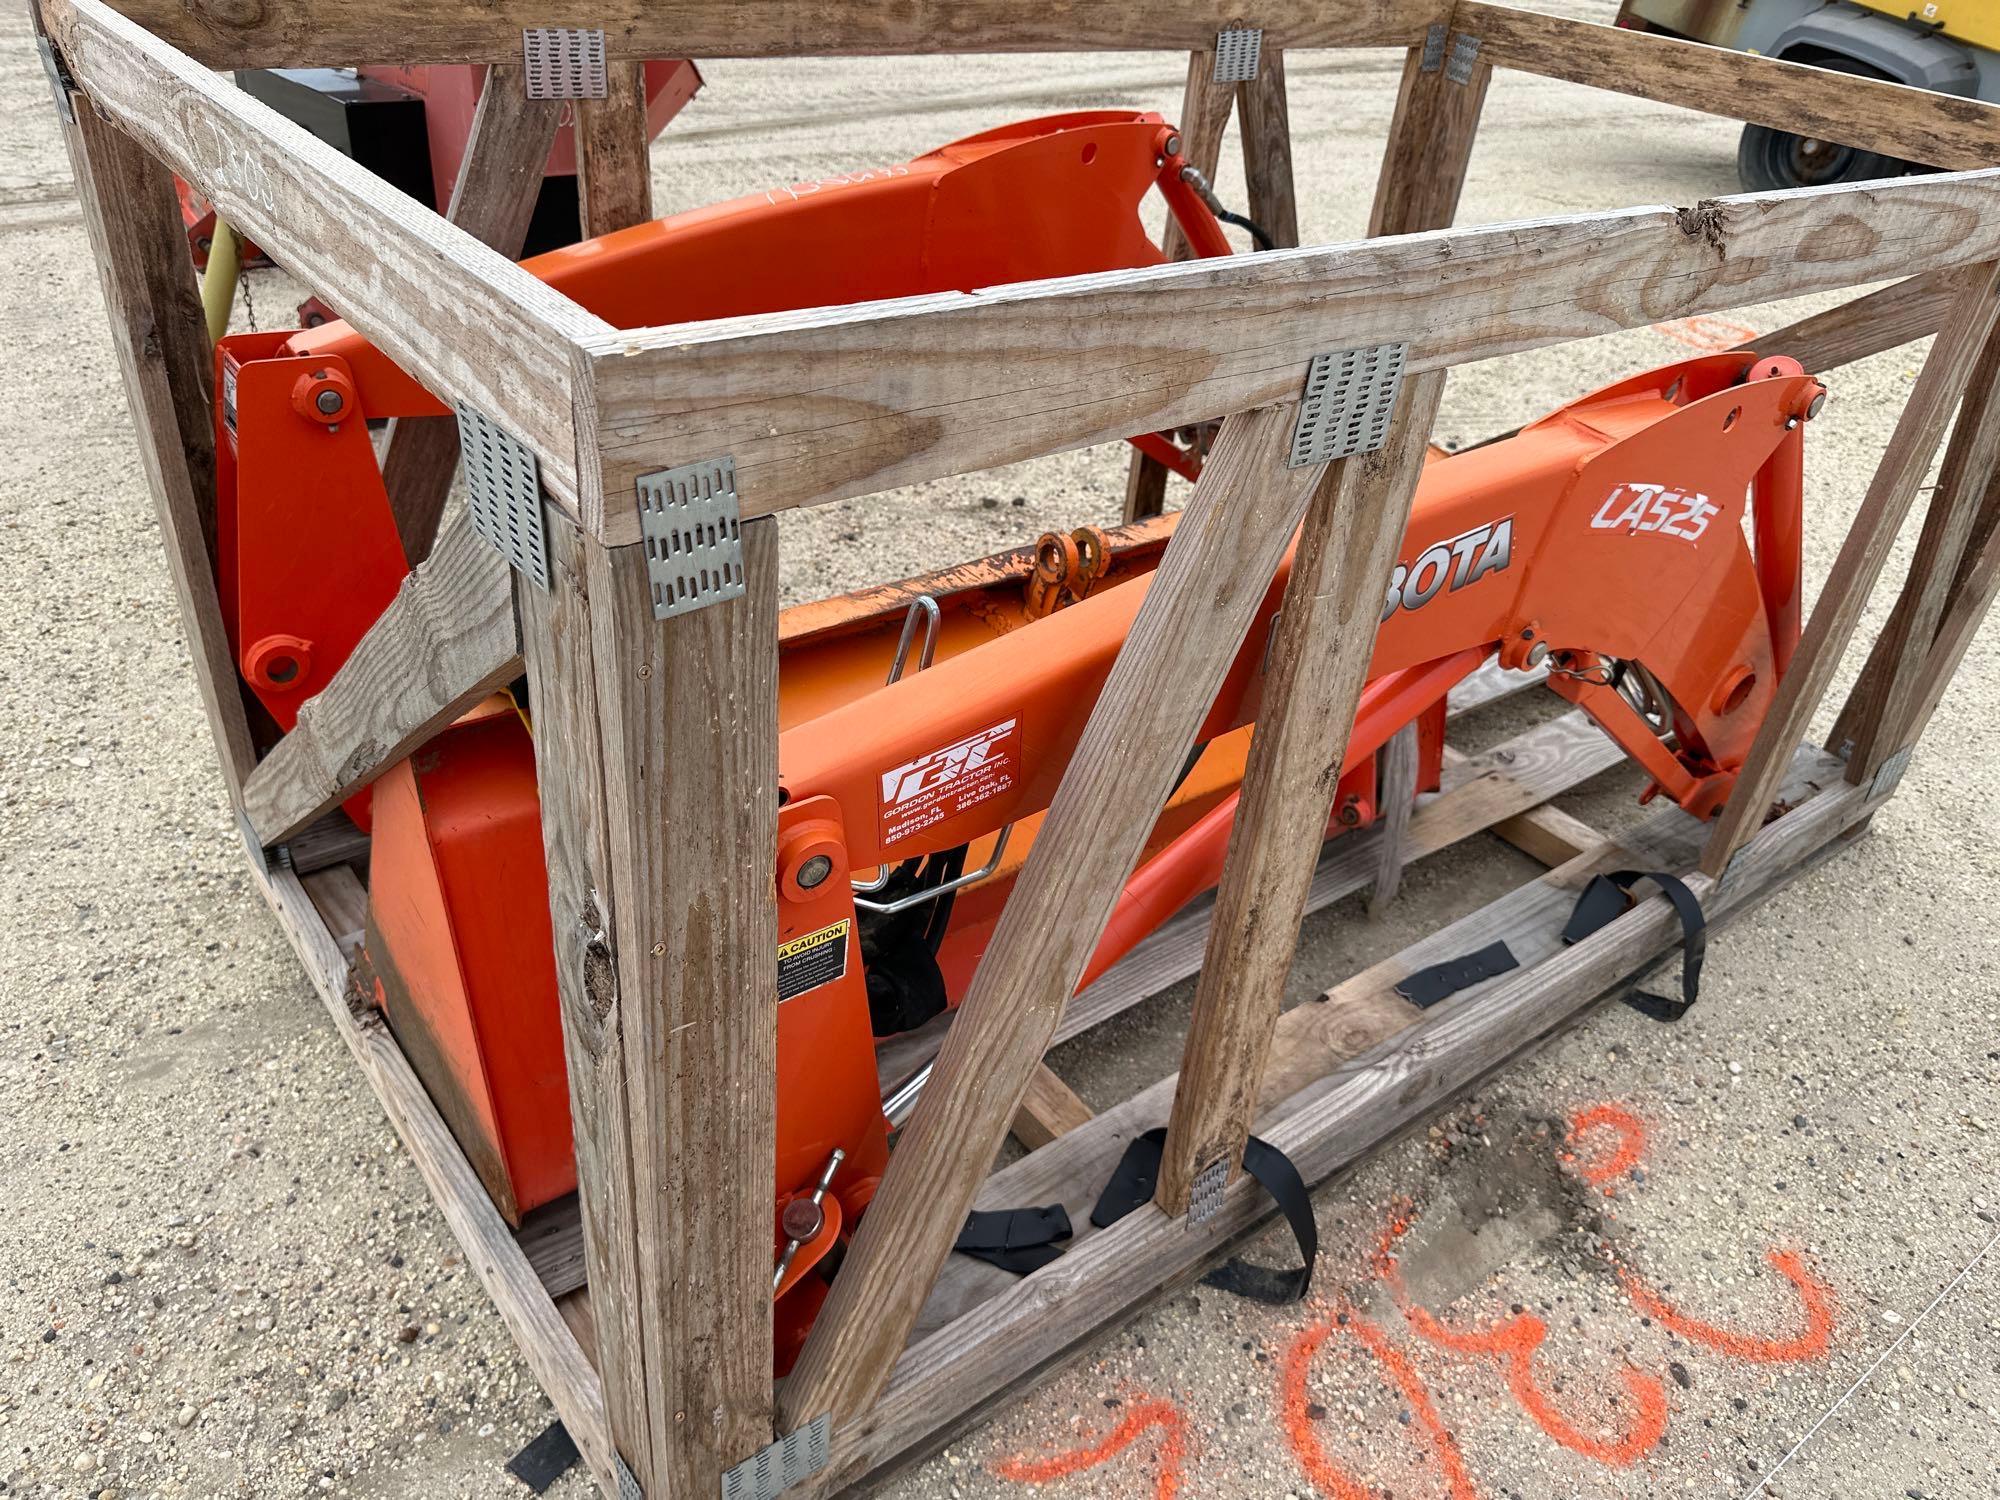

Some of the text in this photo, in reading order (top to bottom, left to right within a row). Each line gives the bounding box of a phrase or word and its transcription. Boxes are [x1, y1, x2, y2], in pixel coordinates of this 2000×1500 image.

[1590, 488, 1719, 541] LA525
[1380, 517, 1514, 624] BOTA
[883, 757, 1012, 820] GORDON TRACTOR INC.
[958, 773, 1011, 802] Live Oak, FL
[885, 811, 945, 845] 850-973-2245
[887, 805, 942, 835] Madison, FL
[783, 941, 833, 965] TO AVOID INJURY
[790, 926, 843, 953] CAUTION
[783, 960, 801, 972] FROM
